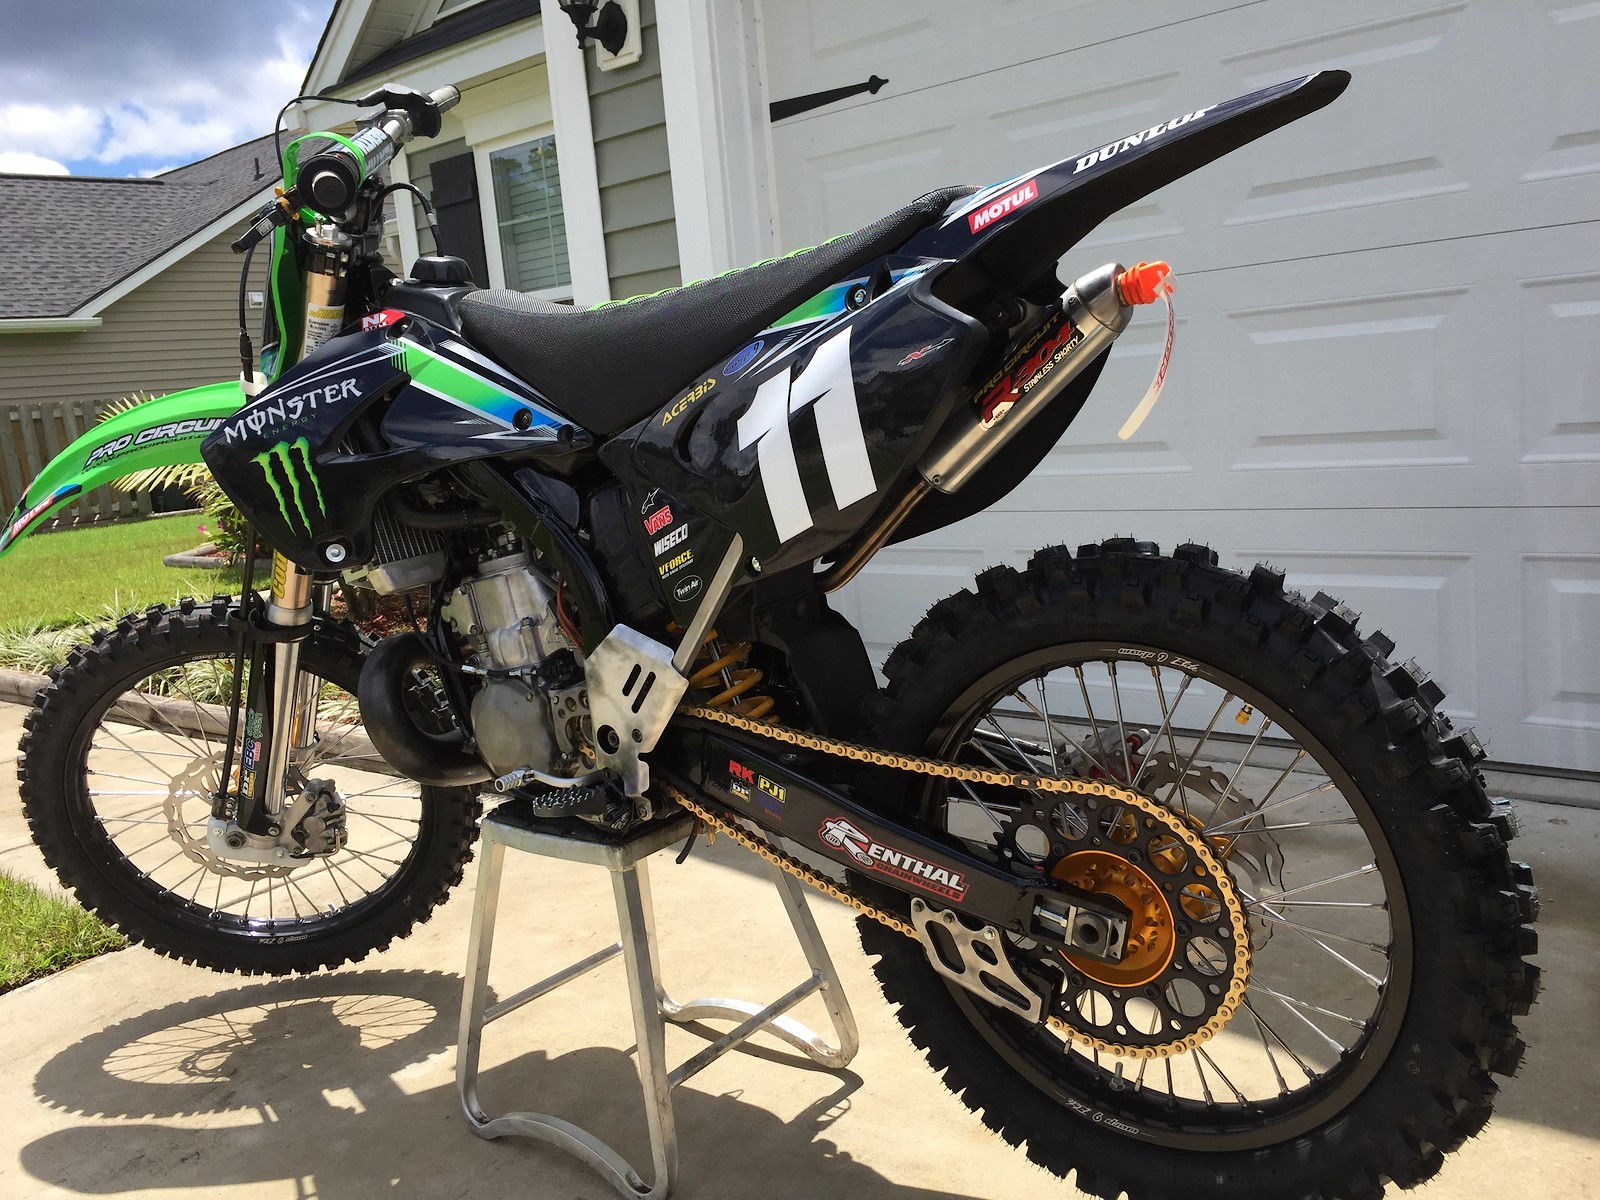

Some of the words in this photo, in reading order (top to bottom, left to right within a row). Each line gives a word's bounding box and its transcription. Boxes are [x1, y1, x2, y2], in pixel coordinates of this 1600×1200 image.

[974, 186, 1034, 230] MOTUL
[1023, 361, 1054, 393] STAINLESS
[1053, 336, 1080, 363] SHORTY
[263, 413, 317, 439] ENERGY
[737, 325, 877, 544] 11
[83, 433, 133, 470] PRO
[134, 417, 228, 446] CIRCUI
[644, 505, 673, 536] VANS
[653, 523, 689, 557] WISECO
[658, 548, 694, 576] VFORCE
[676, 584, 691, 597] Twin
[690, 579, 700, 590] Air
[243, 737, 256, 770] EBC
[729, 759, 755, 784] RK
[760, 777, 784, 801] PJ1
[821, 820, 965, 892] RENTHAL
[876, 861, 962, 900] CHAINWHEELS
